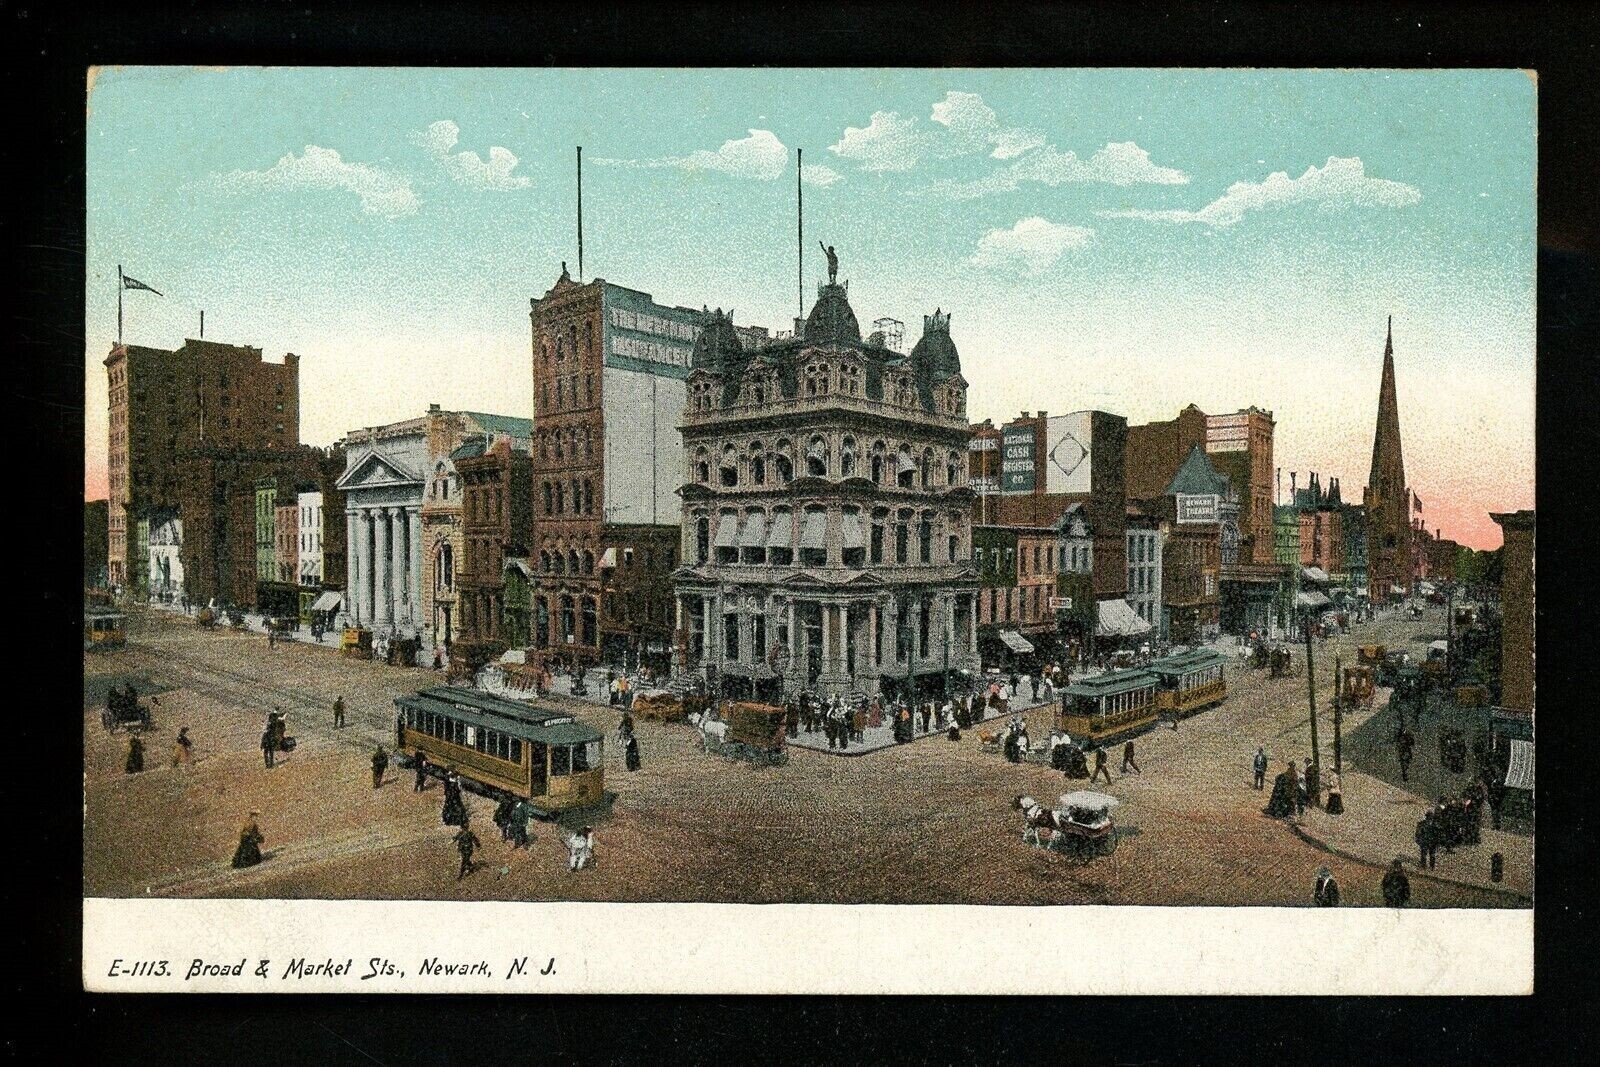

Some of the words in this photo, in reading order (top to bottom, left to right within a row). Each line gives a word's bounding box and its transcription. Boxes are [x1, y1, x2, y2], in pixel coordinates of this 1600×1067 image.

[1007, 446, 1029, 459] CASH
[1003, 460, 1035, 472] REGISTER
[108, 959, 171, 977] E-1113.
[185, 958, 247, 980] Broad
[255, 959, 270, 978] &
[282, 958, 353, 979] Market
[419, 957, 492, 978] Newark,
[506, 956, 528, 979] N.
[540, 957, 557, 976] J.
